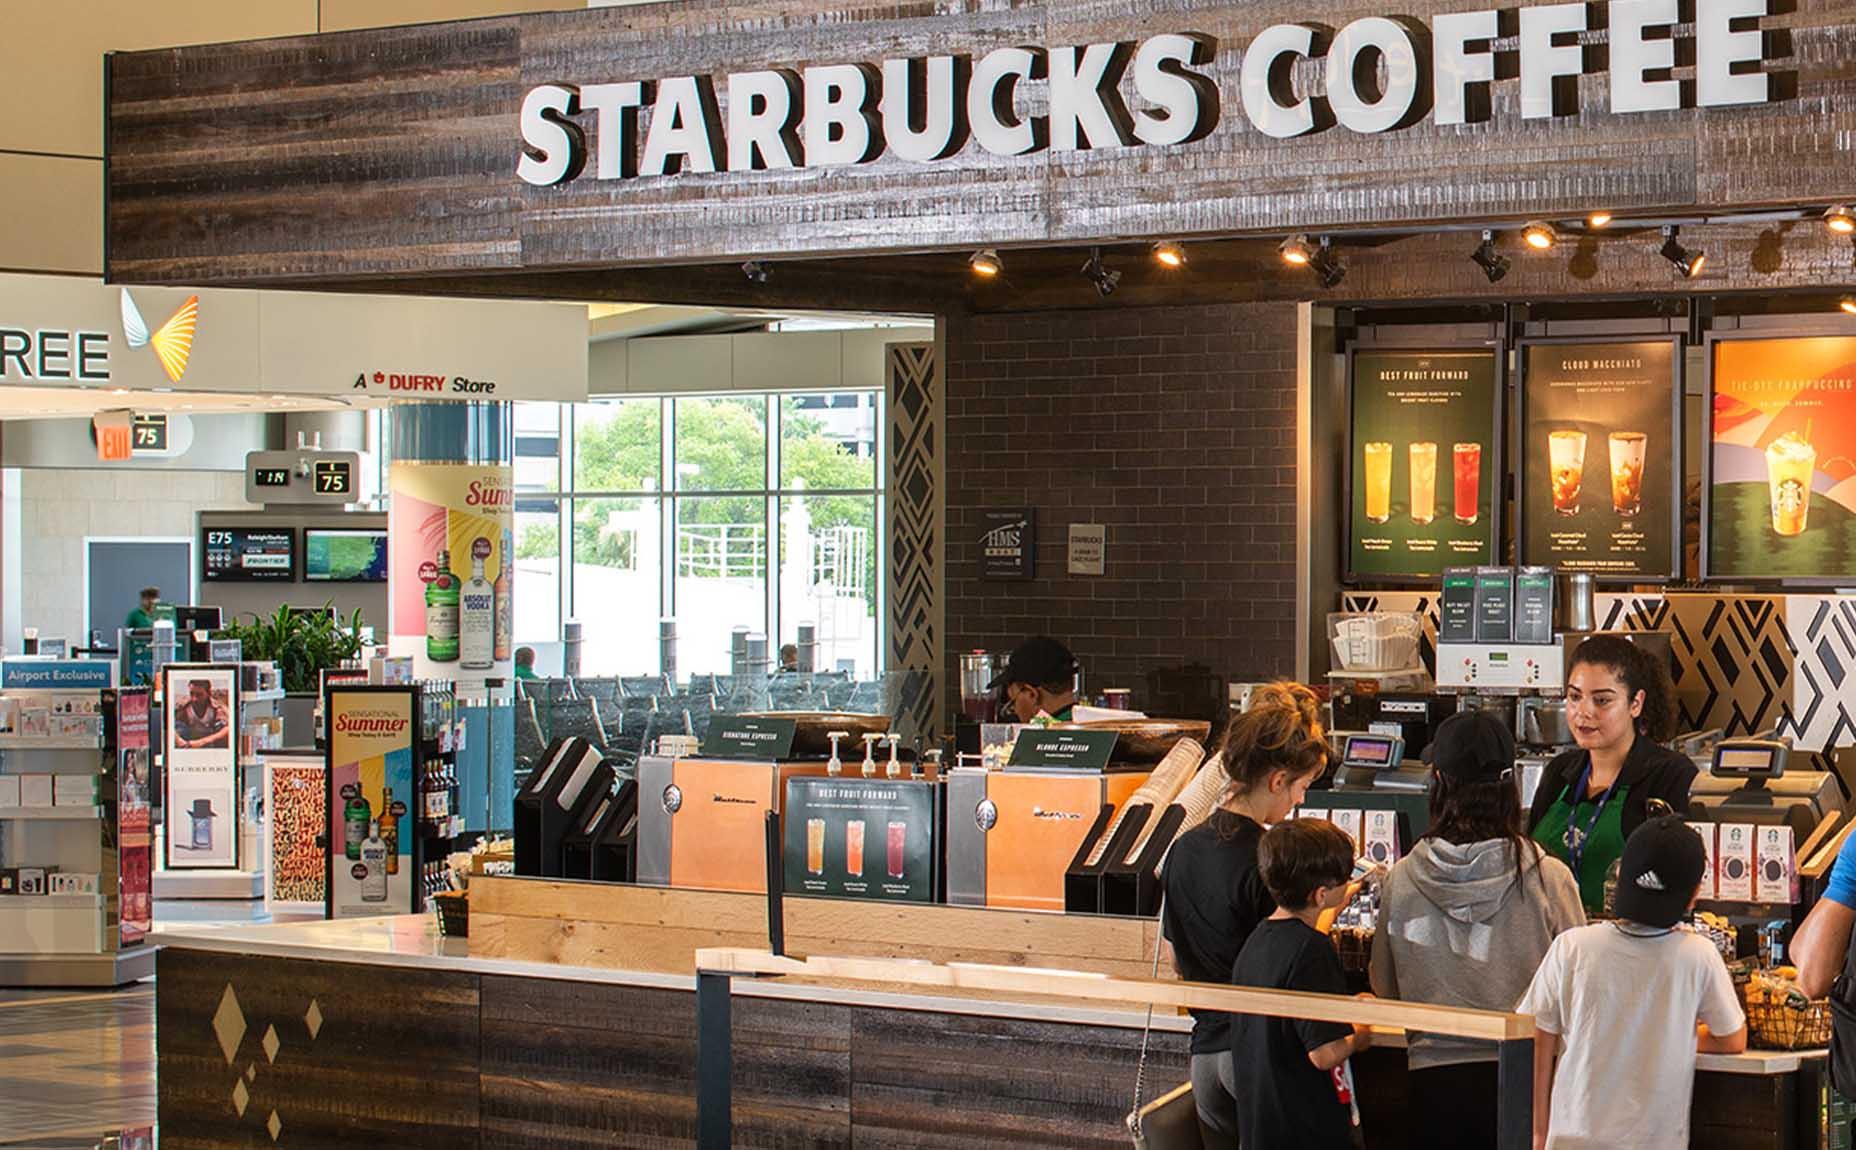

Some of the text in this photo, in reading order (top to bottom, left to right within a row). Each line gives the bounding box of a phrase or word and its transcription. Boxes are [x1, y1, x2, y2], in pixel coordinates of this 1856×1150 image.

[516, 0, 1769, 187] STARBUCKS COFFEE
[0, 330, 110, 379] REE
[1562, 359, 1641, 370] CLOUD MACCHIATO
[1380, 370, 1468, 380] BEST FRUIT FORWARD
[354, 373, 496, 394] A DUFRY Store
[137, 429, 157, 444] 75
[323, 475, 344, 491] 75
[208, 532, 233, 544] E75
[8, 669, 106, 683] Airport Exclusive
[335, 713, 409, 732] Summer
[1059, 744, 1090, 752] ESPRESSO
[819, 788, 898, 800] BEST FRUIT FORWARD
